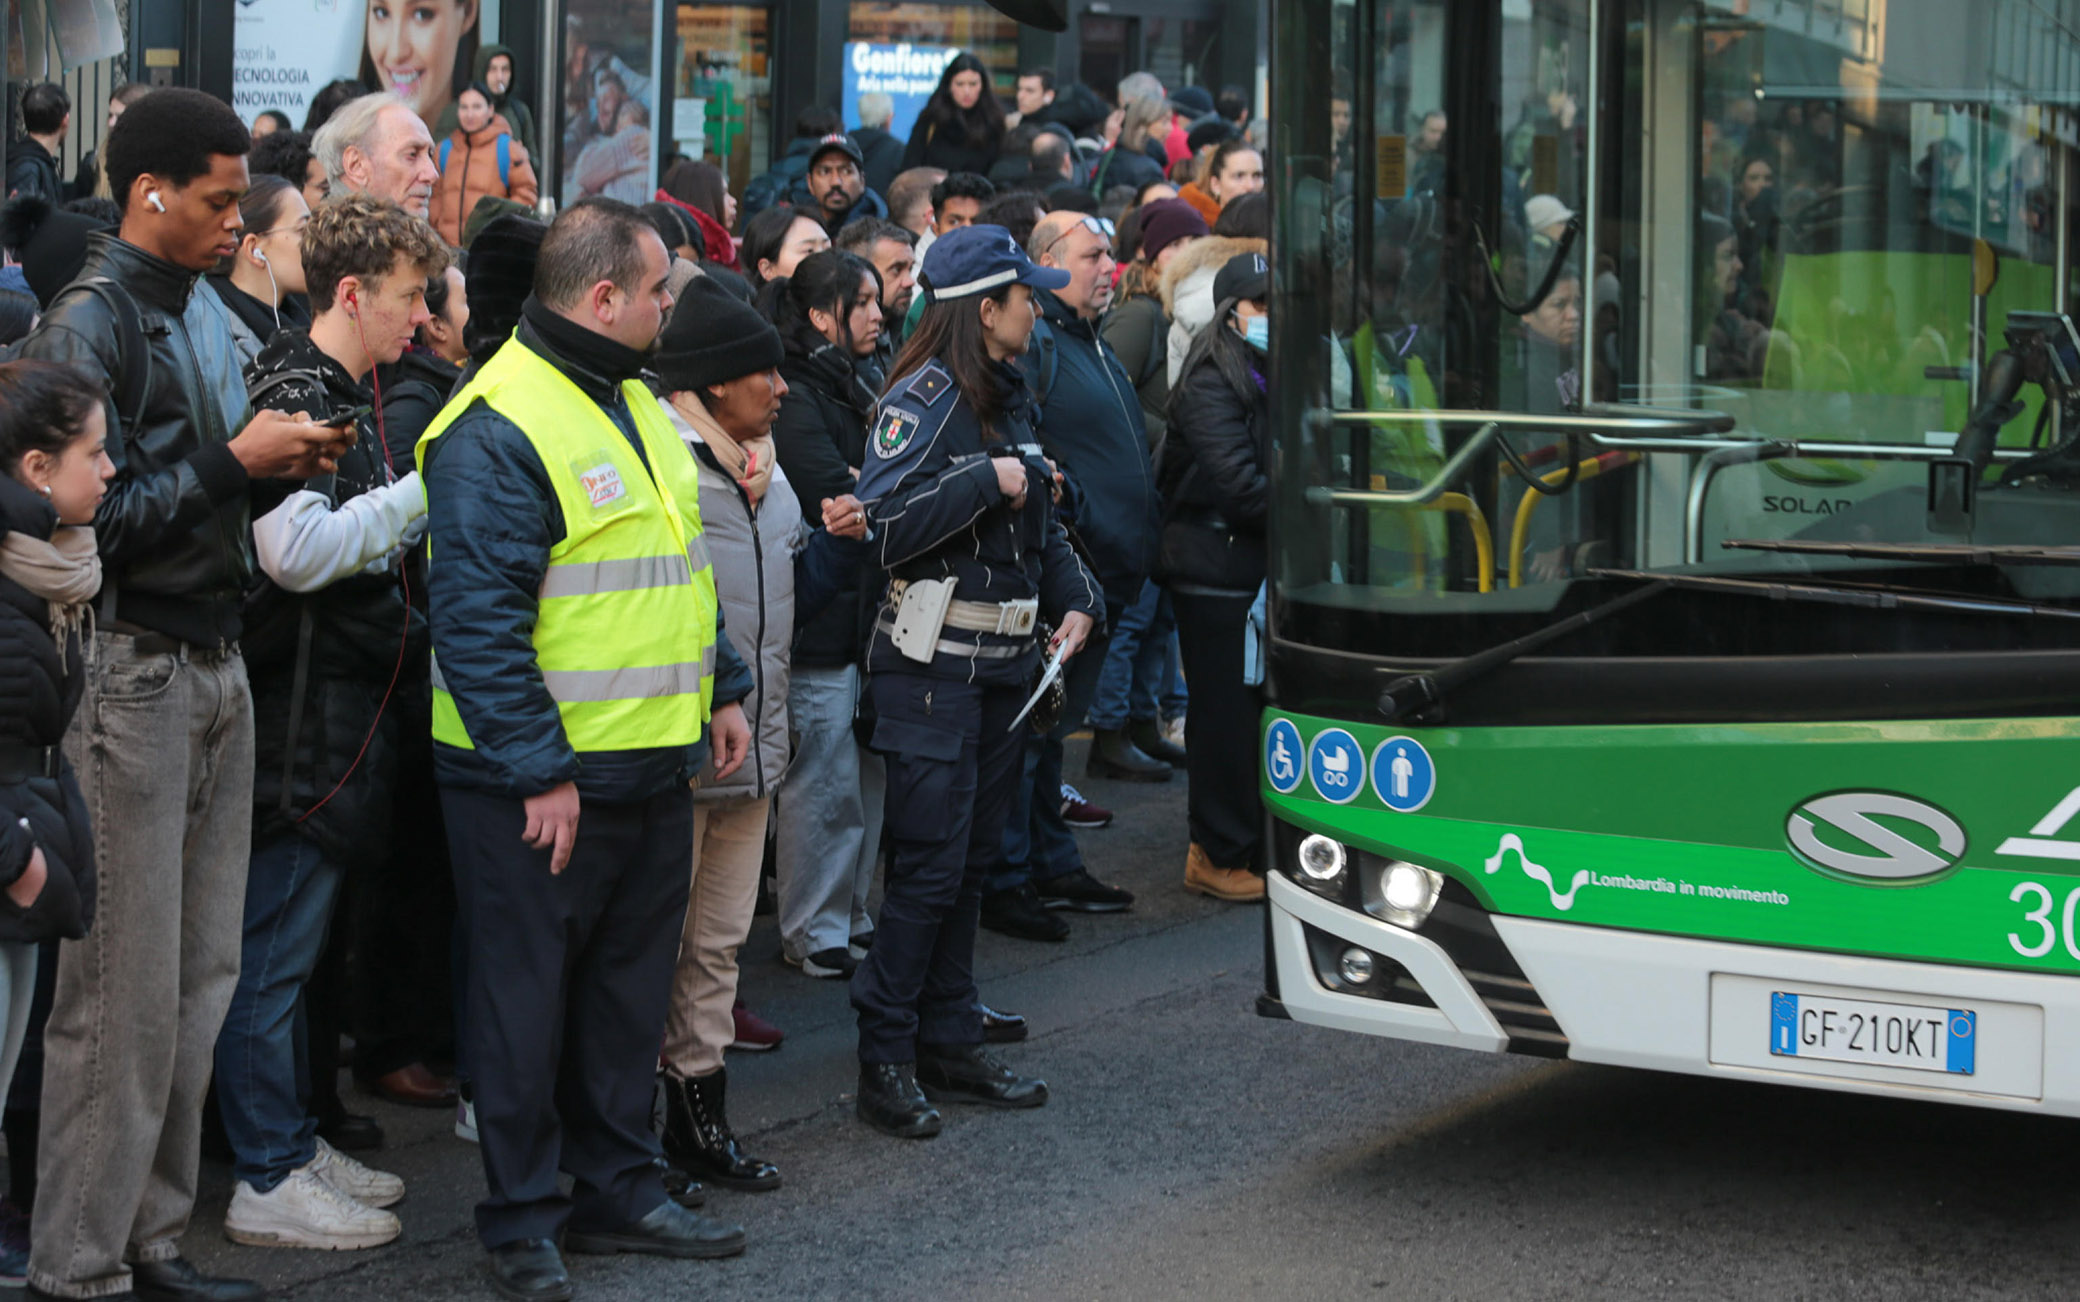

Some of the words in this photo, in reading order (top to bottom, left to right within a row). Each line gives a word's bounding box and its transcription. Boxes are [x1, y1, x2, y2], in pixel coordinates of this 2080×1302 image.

[234, 45, 262, 63] copri
[234, 68, 310, 83] ECNOLOGIA
[233, 91, 305, 106] NNOVATIVA
[1591, 871, 1676, 893] Lombardia
[1679, 880, 1695, 895] in
[1698, 885, 1789, 905] movimento
